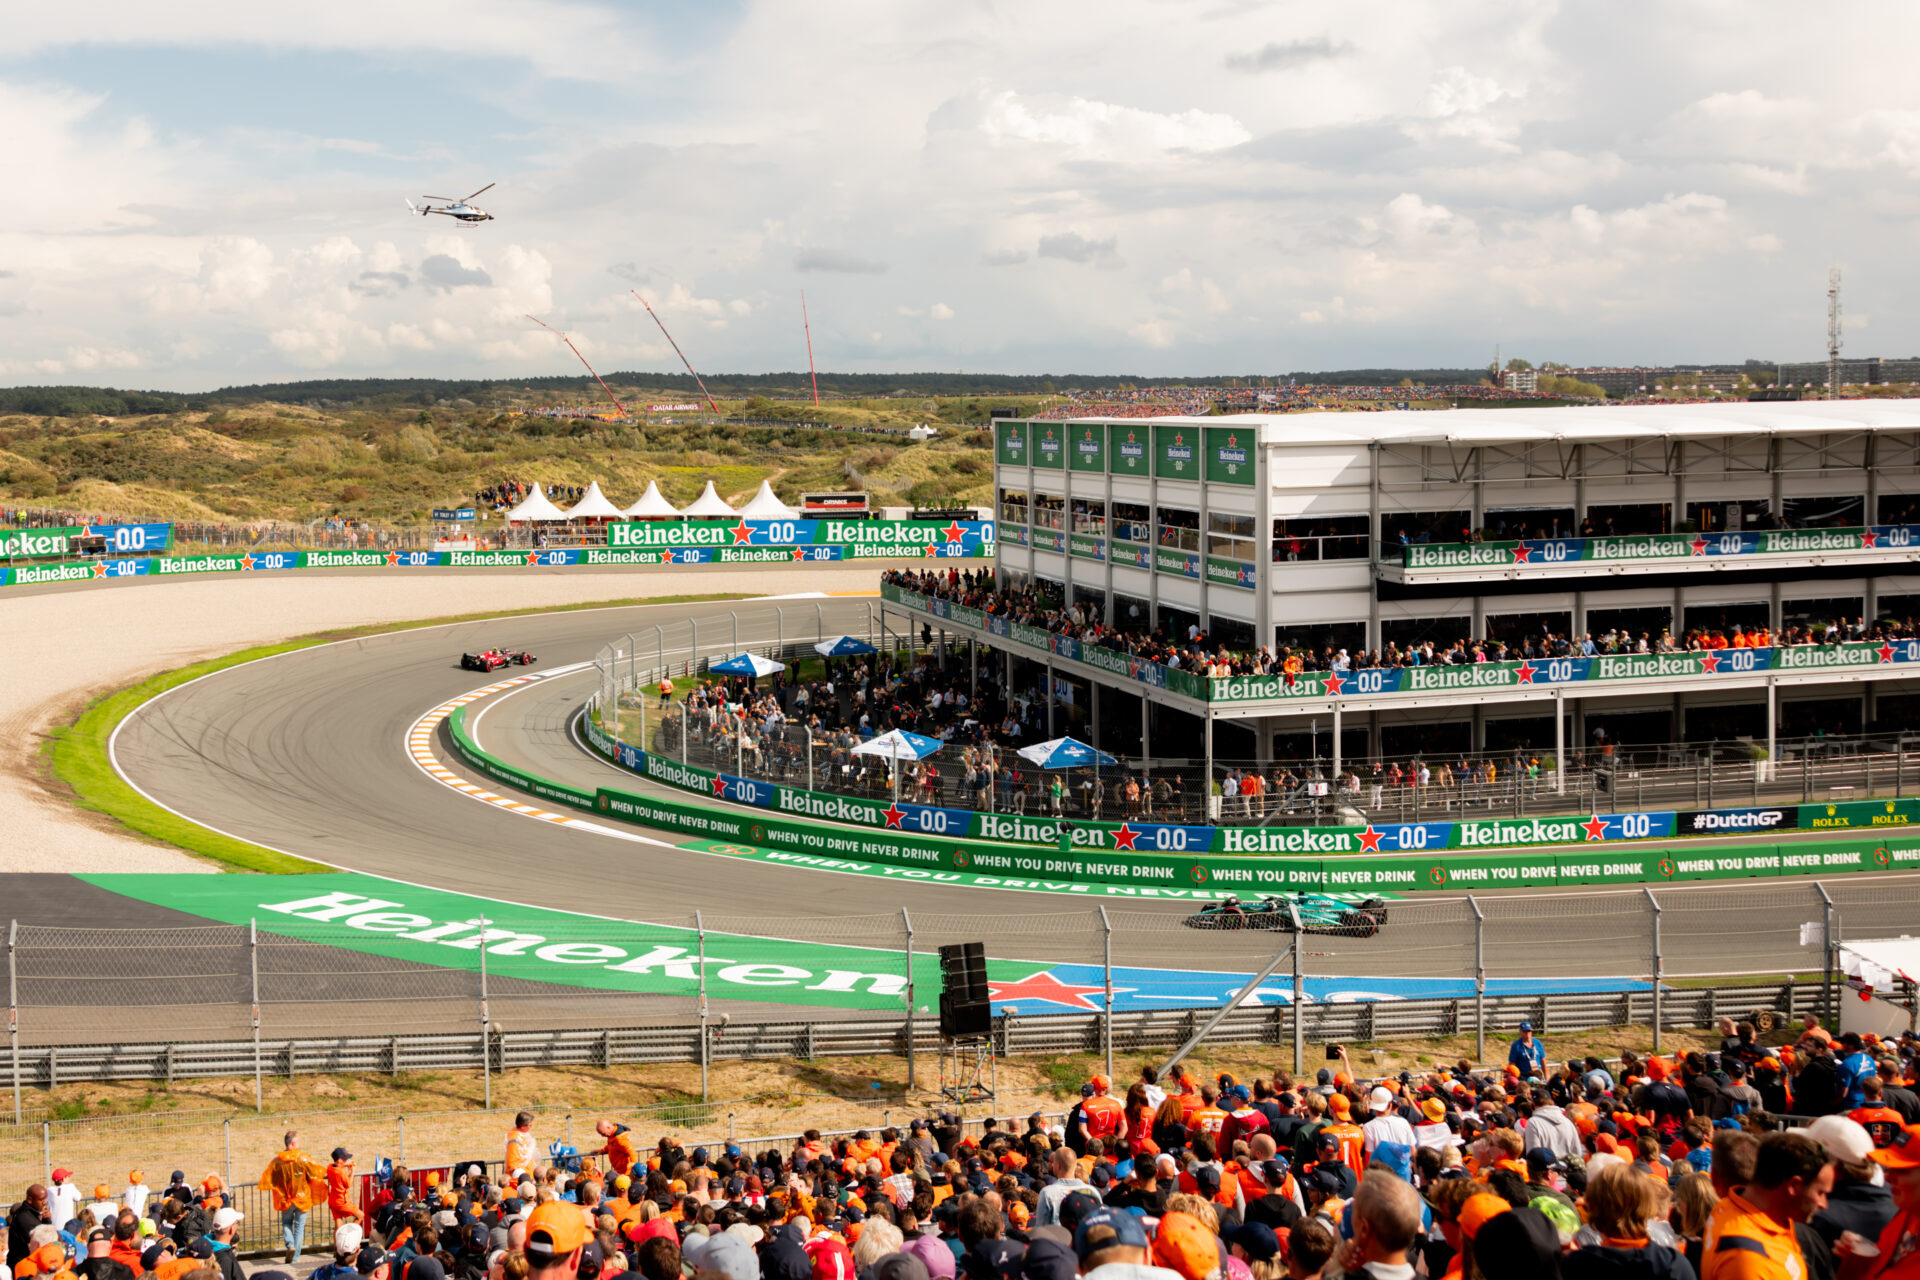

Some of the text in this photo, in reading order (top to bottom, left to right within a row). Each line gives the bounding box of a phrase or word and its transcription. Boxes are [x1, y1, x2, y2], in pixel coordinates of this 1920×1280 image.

[1168, 448, 1191, 458] Heineken
[1220, 451, 1245, 461] Heineken
[116, 527, 145, 550] 0.0
[613, 522, 795, 545] Heineken 0.0
[826, 522, 938, 543] Heineken
[1766, 528, 1909, 551] Heineken 0.0
[450, 550, 522, 565] Heineken
[588, 549, 657, 563] Heineken
[721, 548, 788, 562] Heineken
[854, 543, 921, 557] Heineken
[1112, 547, 1135, 560] Heineken
[1410, 543, 1566, 566] Heineken 0.0
[1592, 535, 1741, 559] Heineken 0.0
[160, 557, 236, 573] Heineken
[307, 552, 381, 567] Heineken
[1157, 555, 1183, 570] Heineken
[1207, 563, 1236, 578] Heineken
[15, 564, 89, 583] Heineken
[900, 590, 927, 610] Heineken
[951, 605, 982, 628] Heineken
[1011, 624, 1048, 649] Heineken
[1082, 644, 1127, 675] Heineken
[1599, 650, 1754, 678] Heineken 0.0
[1780, 642, 1920, 668] Heineken 0.
[1213, 672, 1382, 700] Heineken 0.0
[1410, 661, 1572, 689] Heineken 0.0
[648, 756, 756, 803] Heineken 0.0
[611, 800, 740, 835] WHEN YOU DRIVE NEVER DRINK
[780, 788, 946, 832] Heineken 0.0
[1693, 811, 1783, 829] #DutchGP
[1872, 814, 1909, 824] ROLEX
[1460, 815, 1649, 846] Heineken 0.0
[1813, 817, 1849, 827] ROLEX
[768, 830, 940, 862] WHEN YOU DRIVE NEVER DRINK
[1156, 828, 1187, 850] 0.0
[1223, 827, 1427, 852] Heineken 0.0
[973, 854, 1175, 879] WHEN YOU DRIVE NEVER DRINK
[1450, 862, 1643, 880] WHEN YOU DRIVE NEVER DRINK
[1677, 852, 1861, 873] WHEN YOU DRIVE NEVER DRINK
[766, 852, 873, 871] WHEN
[882, 867, 962, 880] YOU
[974, 877, 1090, 892] DRIVE
[1107, 887, 1238, 899] NEVER
[1211, 869, 1416, 884] WHEN YOU DRIVE NEVER DRINK
[257, 892, 909, 995] Heineken
[1343, 1141, 1349, 1165] 1
